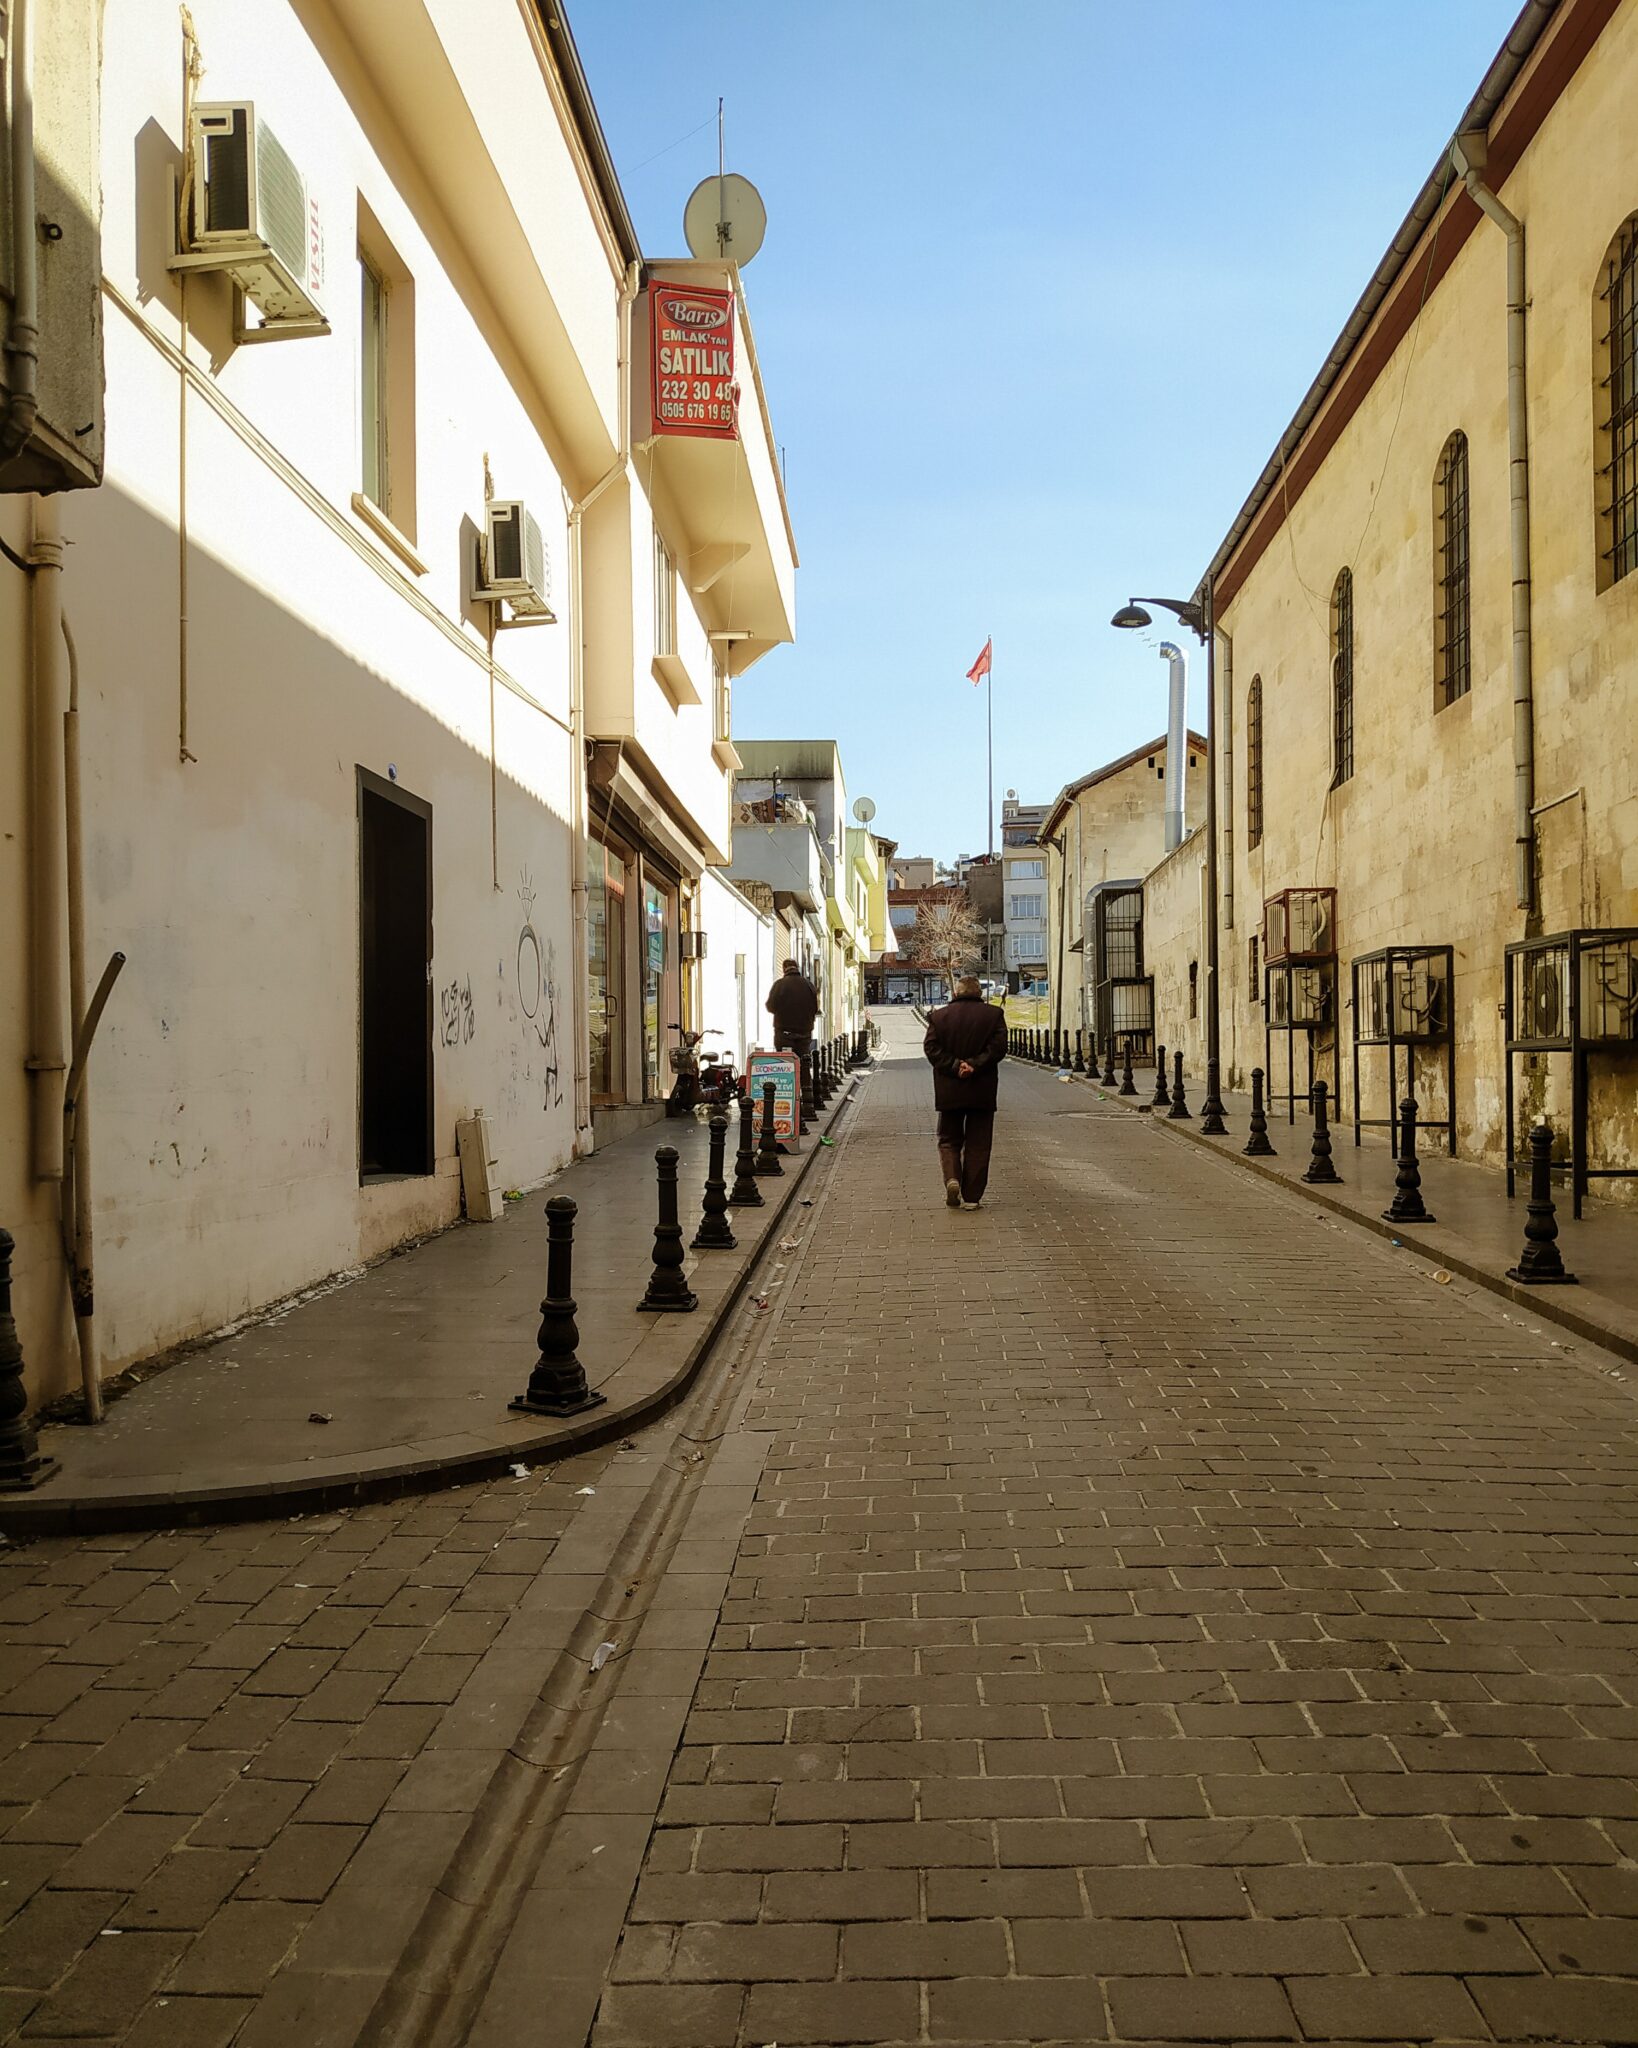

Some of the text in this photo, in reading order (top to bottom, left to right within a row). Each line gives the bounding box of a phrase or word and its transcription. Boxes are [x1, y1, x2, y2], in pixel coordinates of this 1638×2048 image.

[660, 347, 731, 376] SATILIK
[661, 380, 731, 401] 232 30 48
[661, 402, 731, 420] 0505 676 19 65
